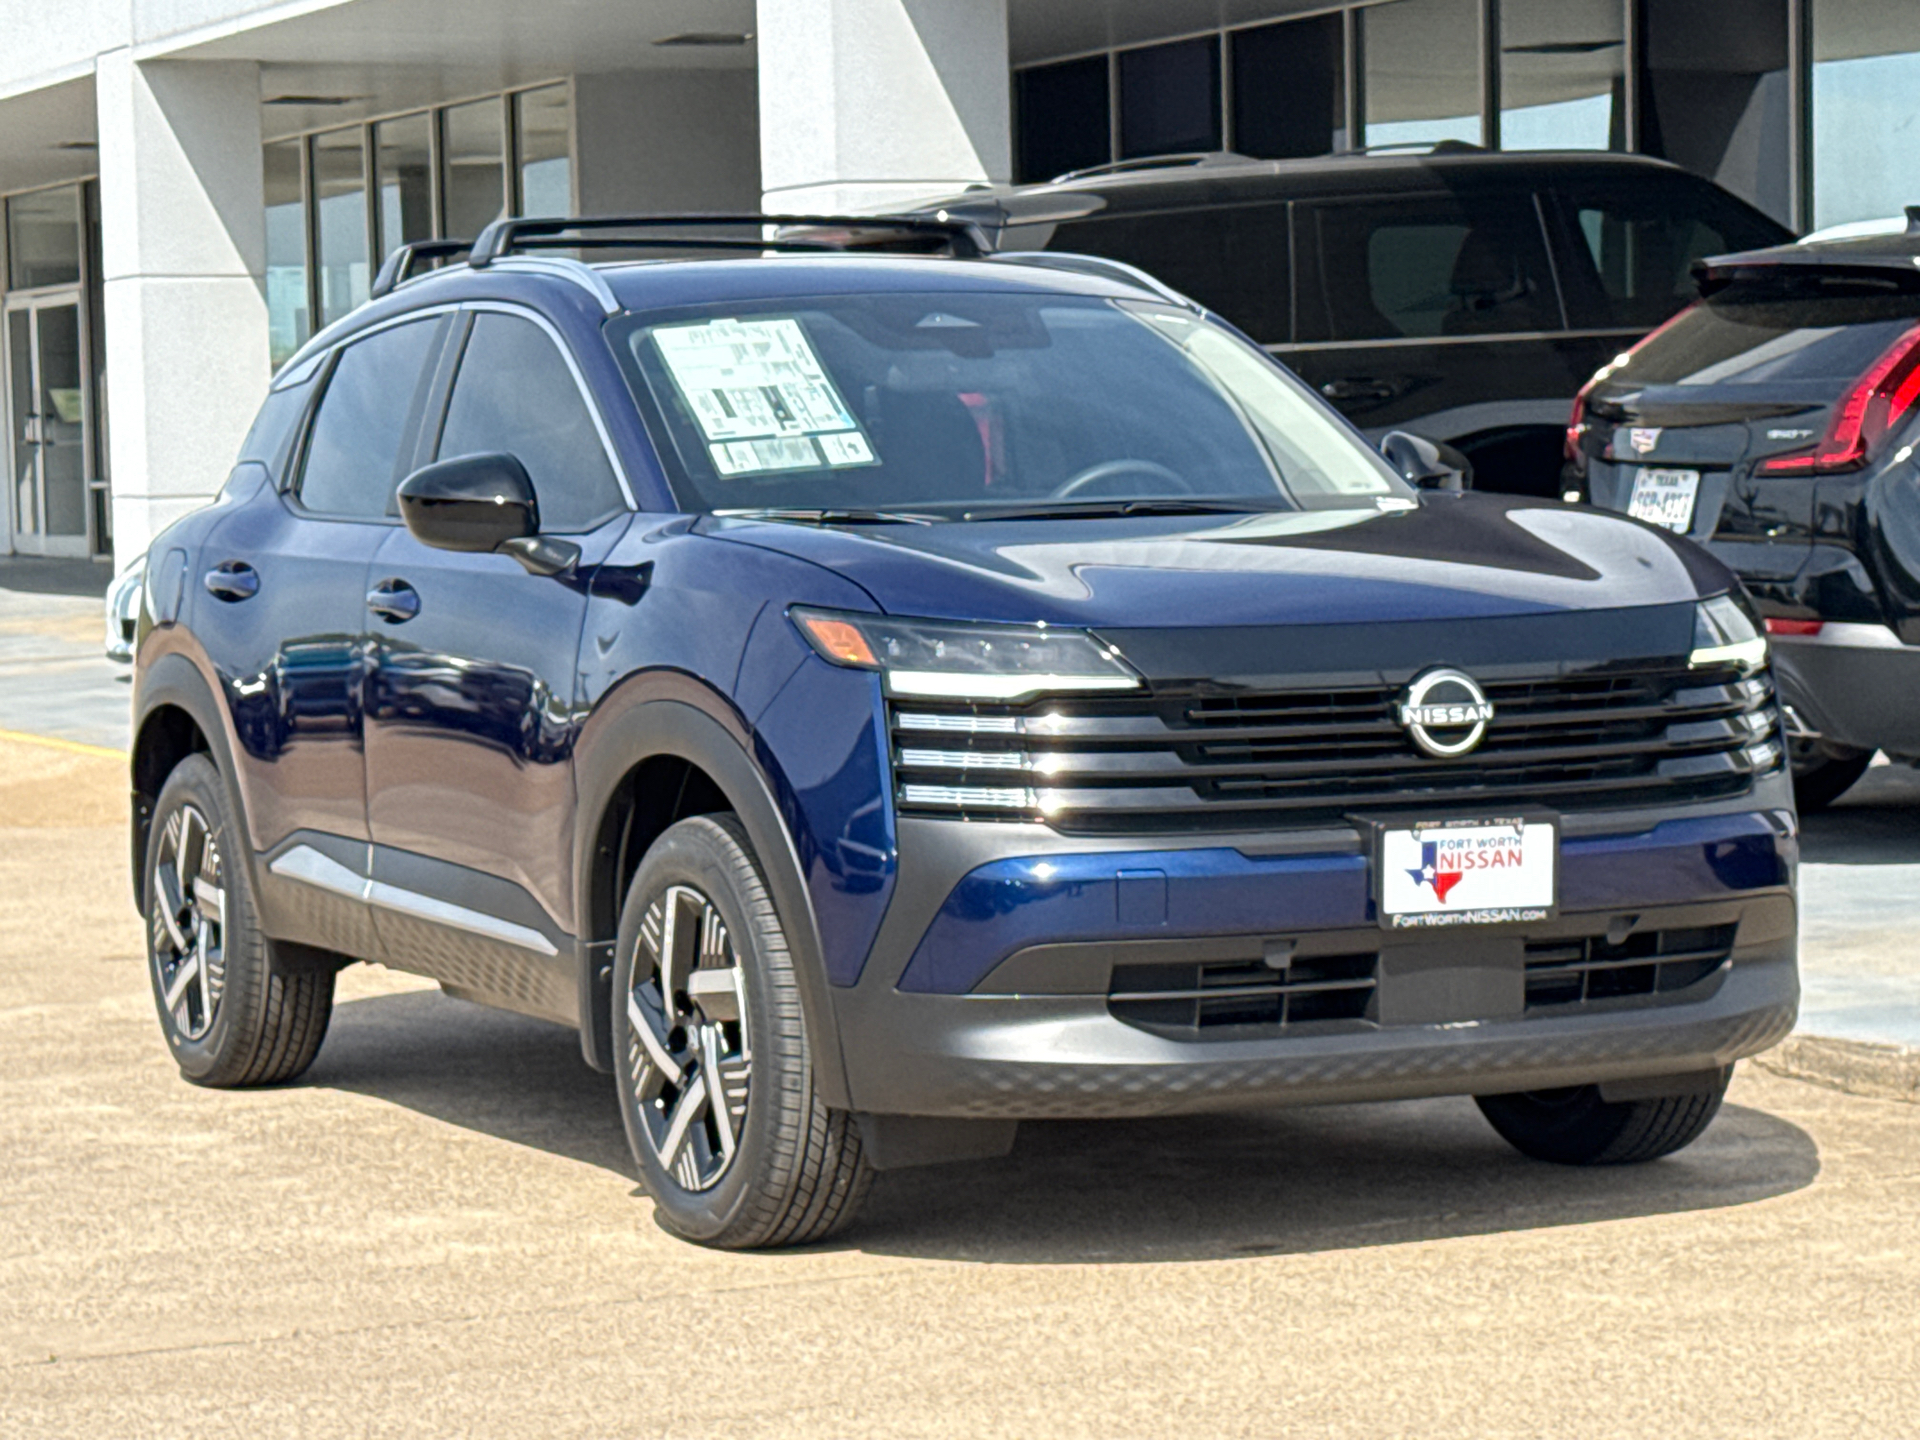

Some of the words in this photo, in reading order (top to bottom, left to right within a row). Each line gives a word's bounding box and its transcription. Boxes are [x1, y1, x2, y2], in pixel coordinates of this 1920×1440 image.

[1402, 704, 1493, 724] NISSAN
[1440, 839, 1472, 850] FORT
[1476, 836, 1522, 849] WORTH
[1440, 848, 1522, 870] NISSAN
